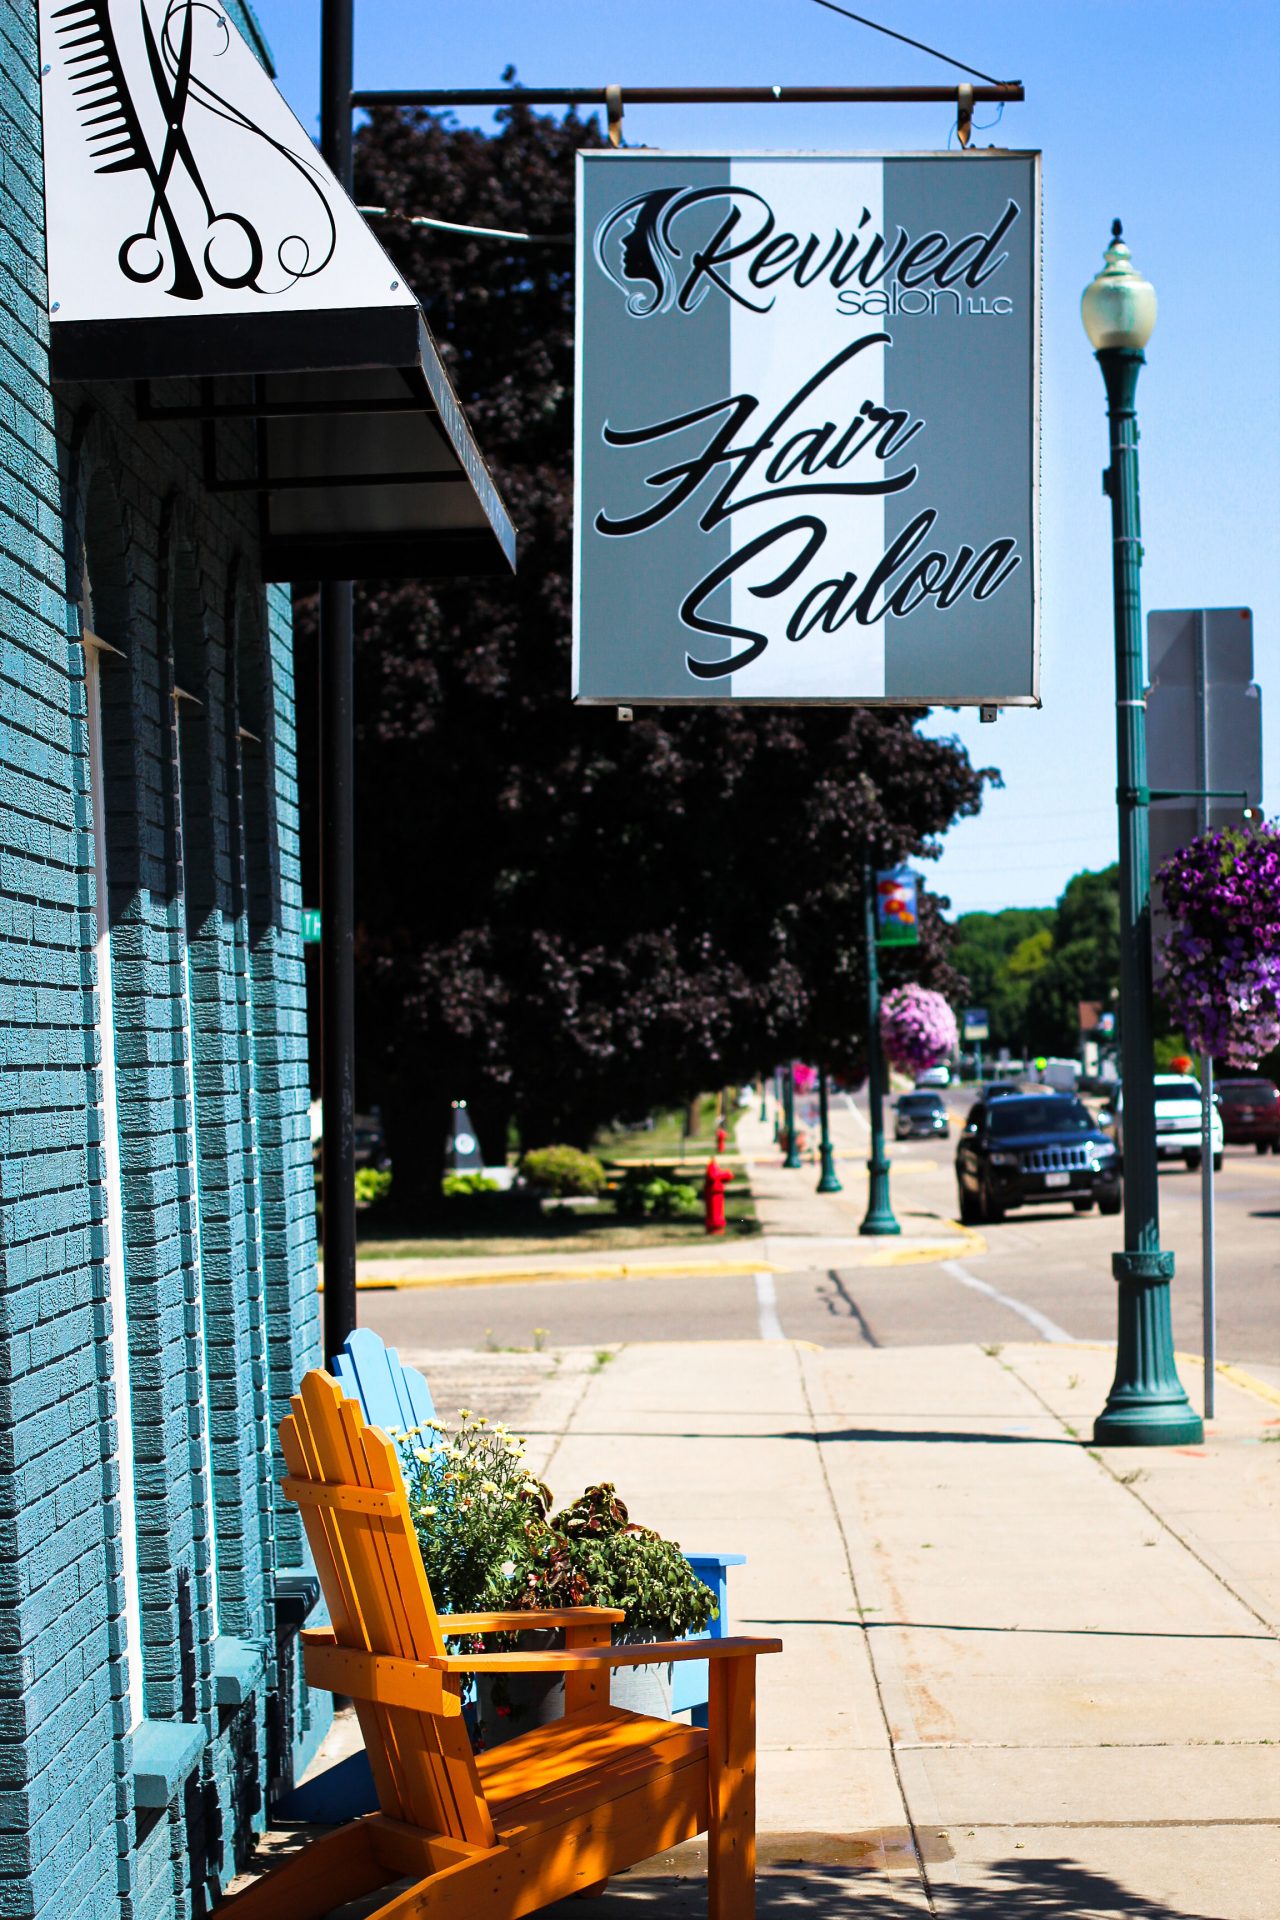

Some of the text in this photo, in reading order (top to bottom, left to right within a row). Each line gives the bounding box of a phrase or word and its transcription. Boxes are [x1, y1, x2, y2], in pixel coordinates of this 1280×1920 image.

[662, 185, 1020, 314] Revived
[836, 281, 1013, 315] salon LLC
[594, 332, 925, 537] Hair
[679, 507, 1022, 680] Salon
